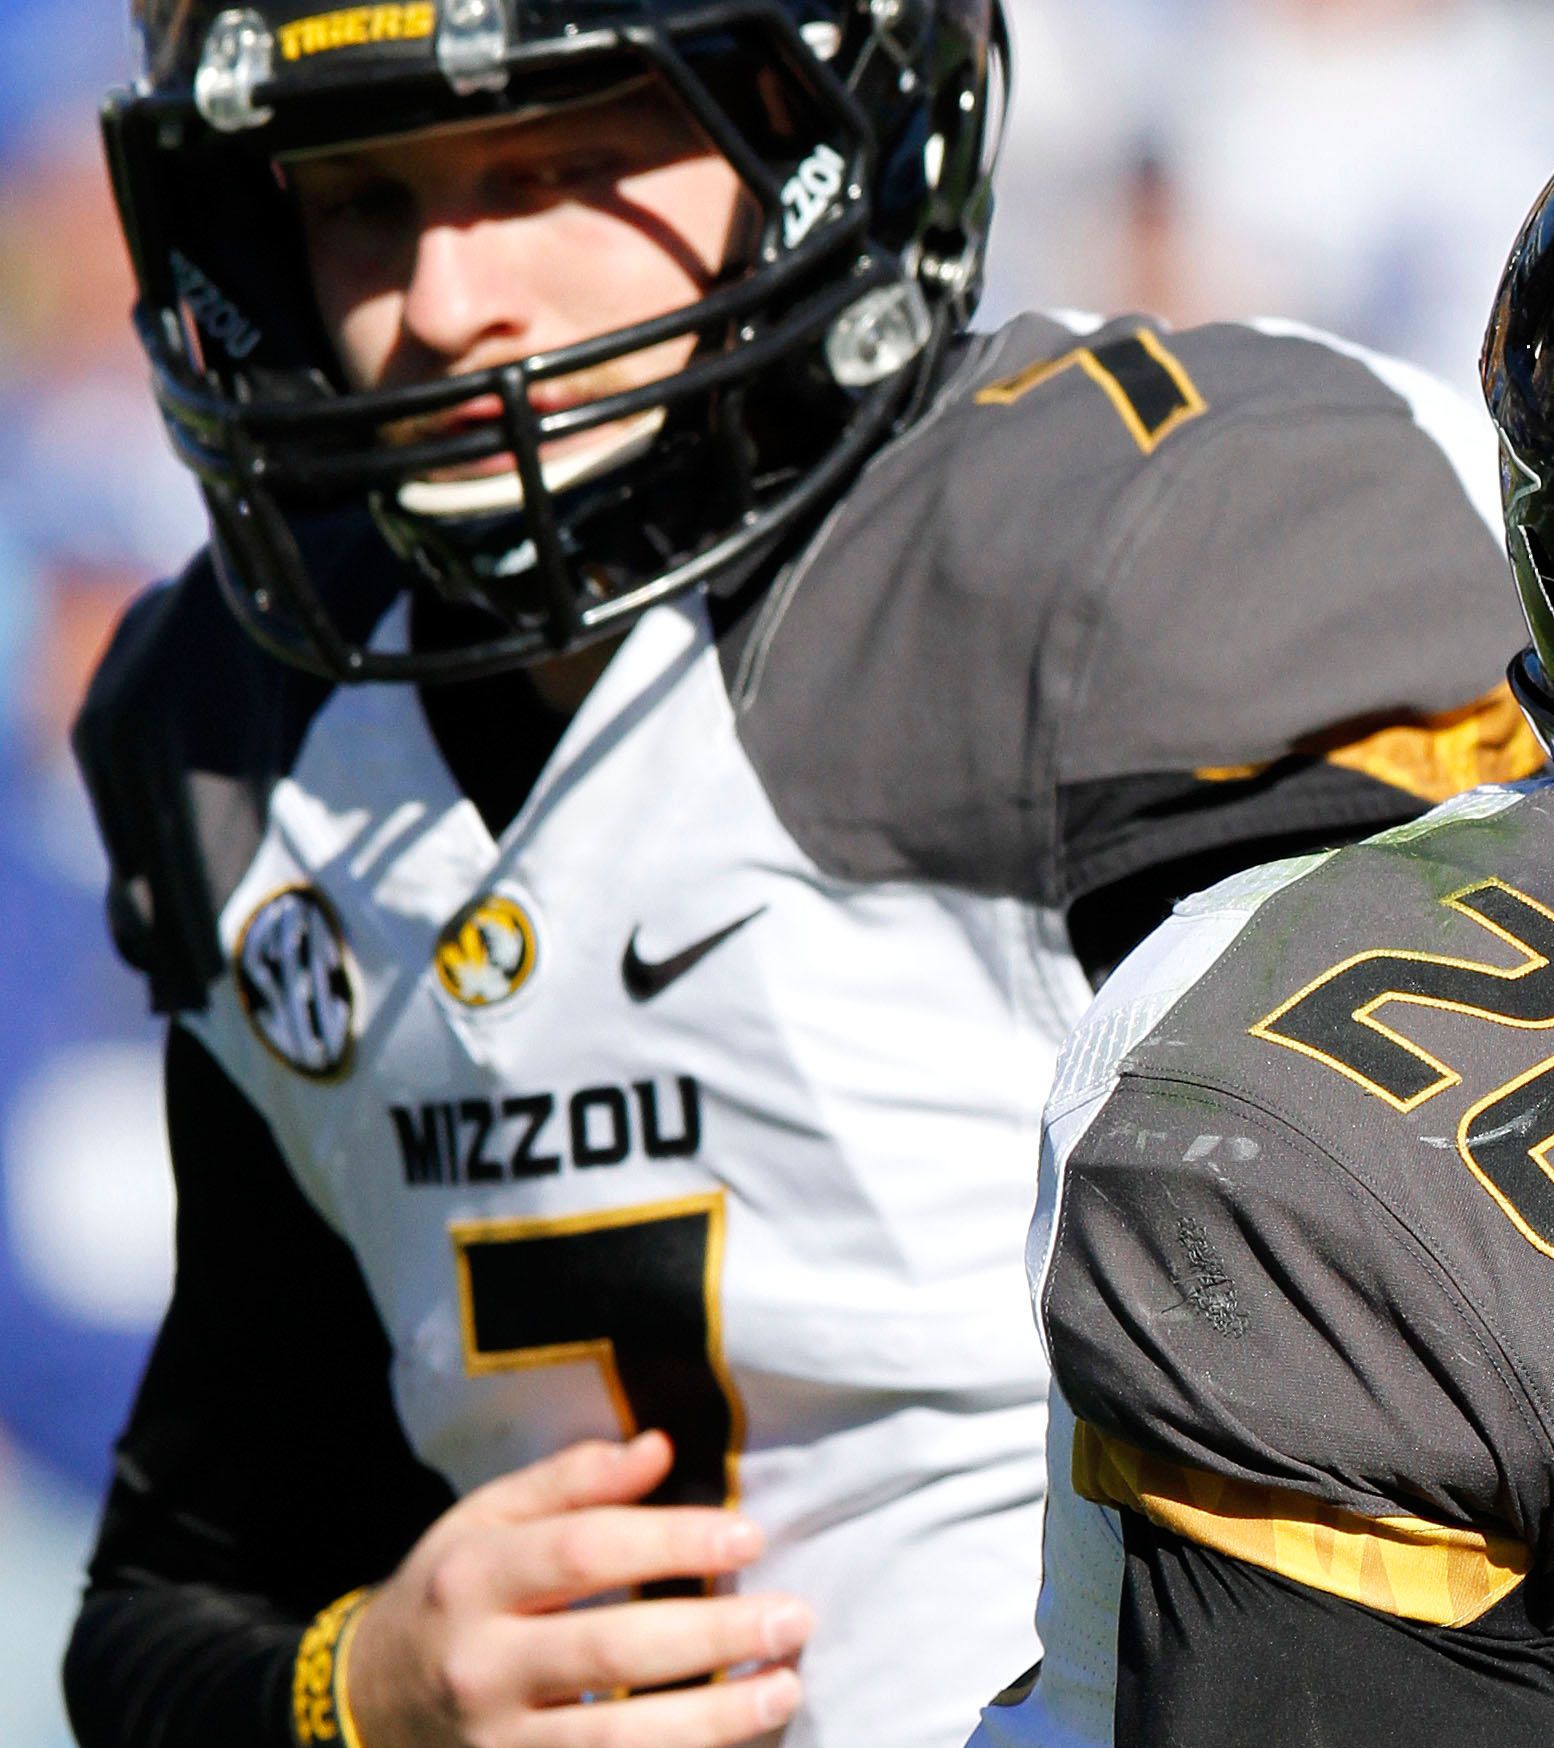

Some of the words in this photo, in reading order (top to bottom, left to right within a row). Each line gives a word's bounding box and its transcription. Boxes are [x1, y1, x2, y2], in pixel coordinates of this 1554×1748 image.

[243, 892, 350, 1068] SEC
[388, 1075, 702, 1186] MIZZOU
[449, 1186, 747, 1700] 7
